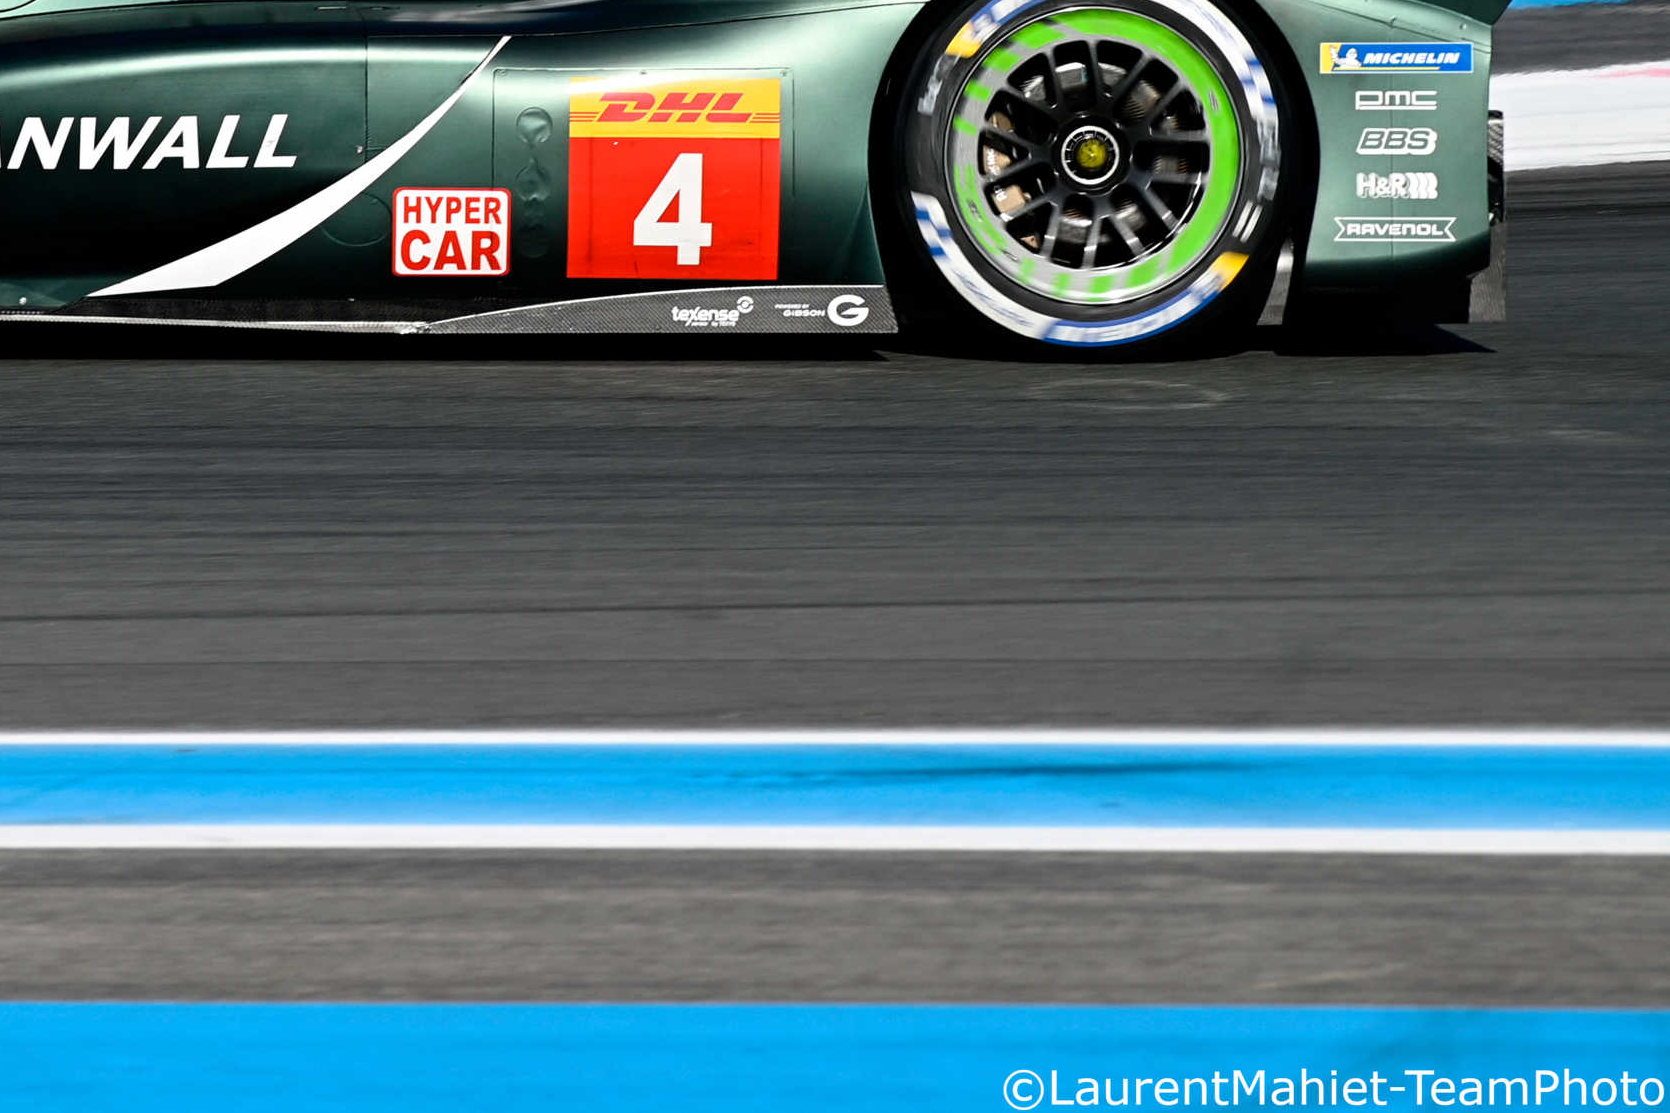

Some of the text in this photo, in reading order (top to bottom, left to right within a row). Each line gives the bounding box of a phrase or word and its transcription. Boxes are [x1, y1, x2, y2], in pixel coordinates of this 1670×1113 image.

[1363, 52, 1460, 64] MICHELIN
[598, 92, 753, 123] DHL
[1356, 128, 1437, 155] BBS
[1356, 173, 1420, 199] H&R
[403, 197, 501, 224] HYPER
[633, 153, 713, 265] 4
[1346, 224, 1444, 235] RAVENOL
[400, 230, 501, 271] CAR
[671, 306, 740, 326] texense
[782, 309, 825, 317] GIBSON
